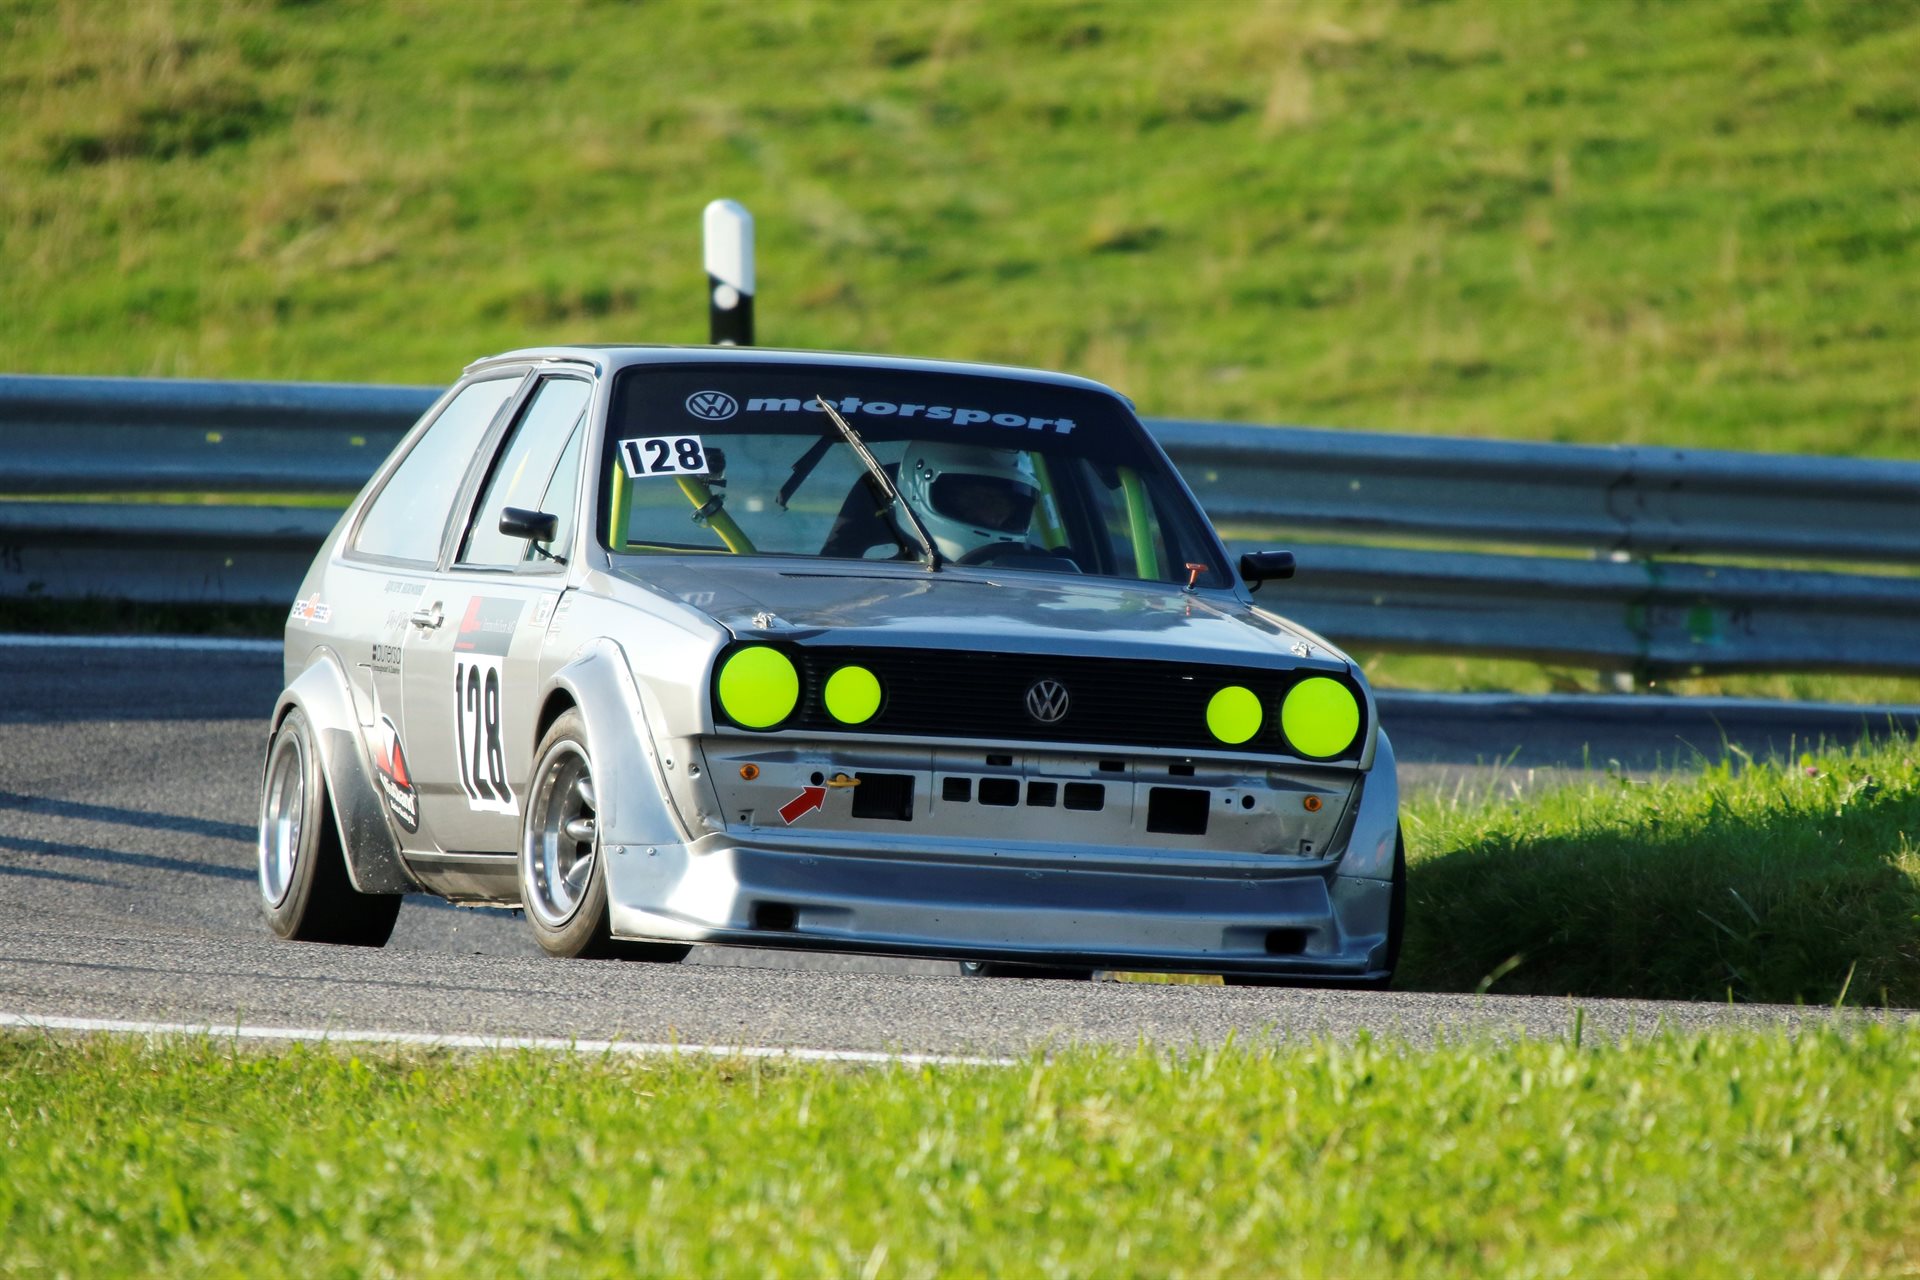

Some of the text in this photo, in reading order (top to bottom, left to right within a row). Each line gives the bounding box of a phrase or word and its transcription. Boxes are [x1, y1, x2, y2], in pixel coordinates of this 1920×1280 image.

[686, 391, 1076, 434] VW motorsport
[625, 437, 704, 475] 128
[1027, 680, 1069, 721] VW
[456, 662, 512, 804] 128
